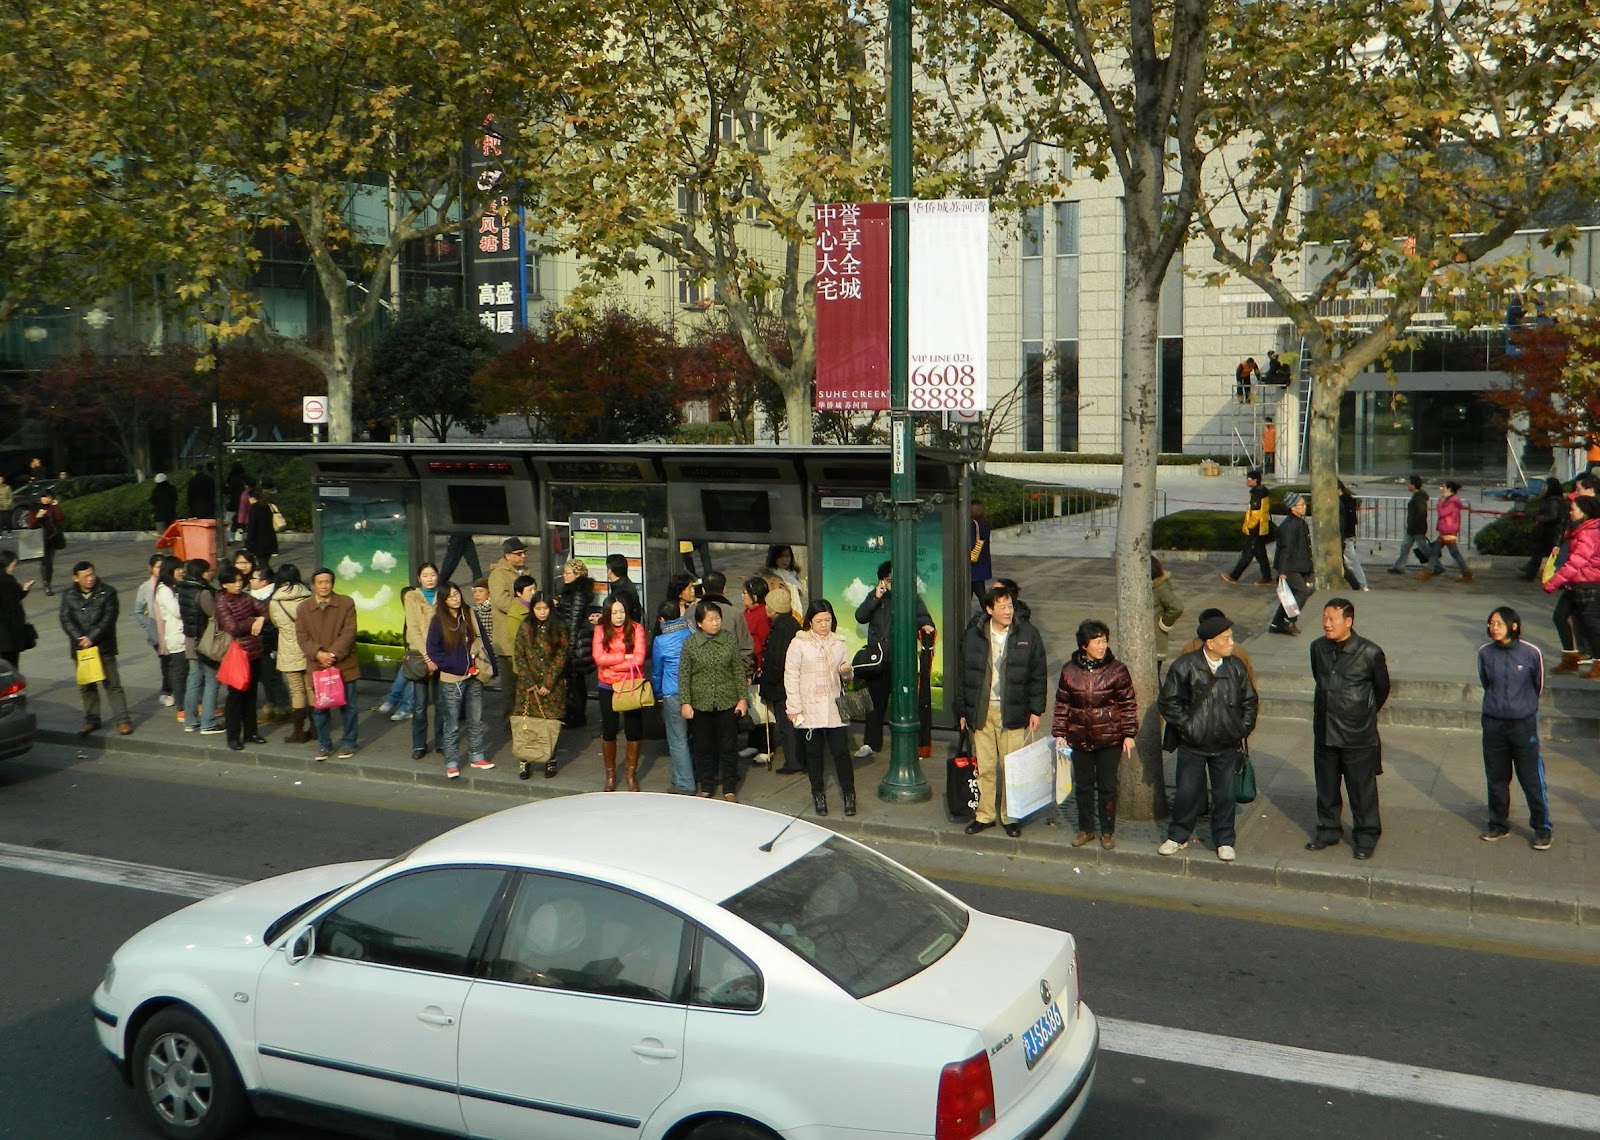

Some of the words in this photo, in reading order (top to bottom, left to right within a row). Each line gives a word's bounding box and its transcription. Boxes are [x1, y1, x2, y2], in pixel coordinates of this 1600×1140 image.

[913, 201, 986, 214] 华侨城苏河湾
[816, 203, 838, 300] 中心大宅
[839, 203, 862, 300] 誉享全城
[478, 281, 514, 305] 高盛
[478, 310, 514, 334] 商厦
[911, 355, 928, 363] VIP
[929, 355, 952, 363] LINE
[911, 364, 975, 387] 6608
[818, 390, 848, 398] SUHE
[851, 390, 887, 398] CREEK
[911, 387, 975, 410] 8888
